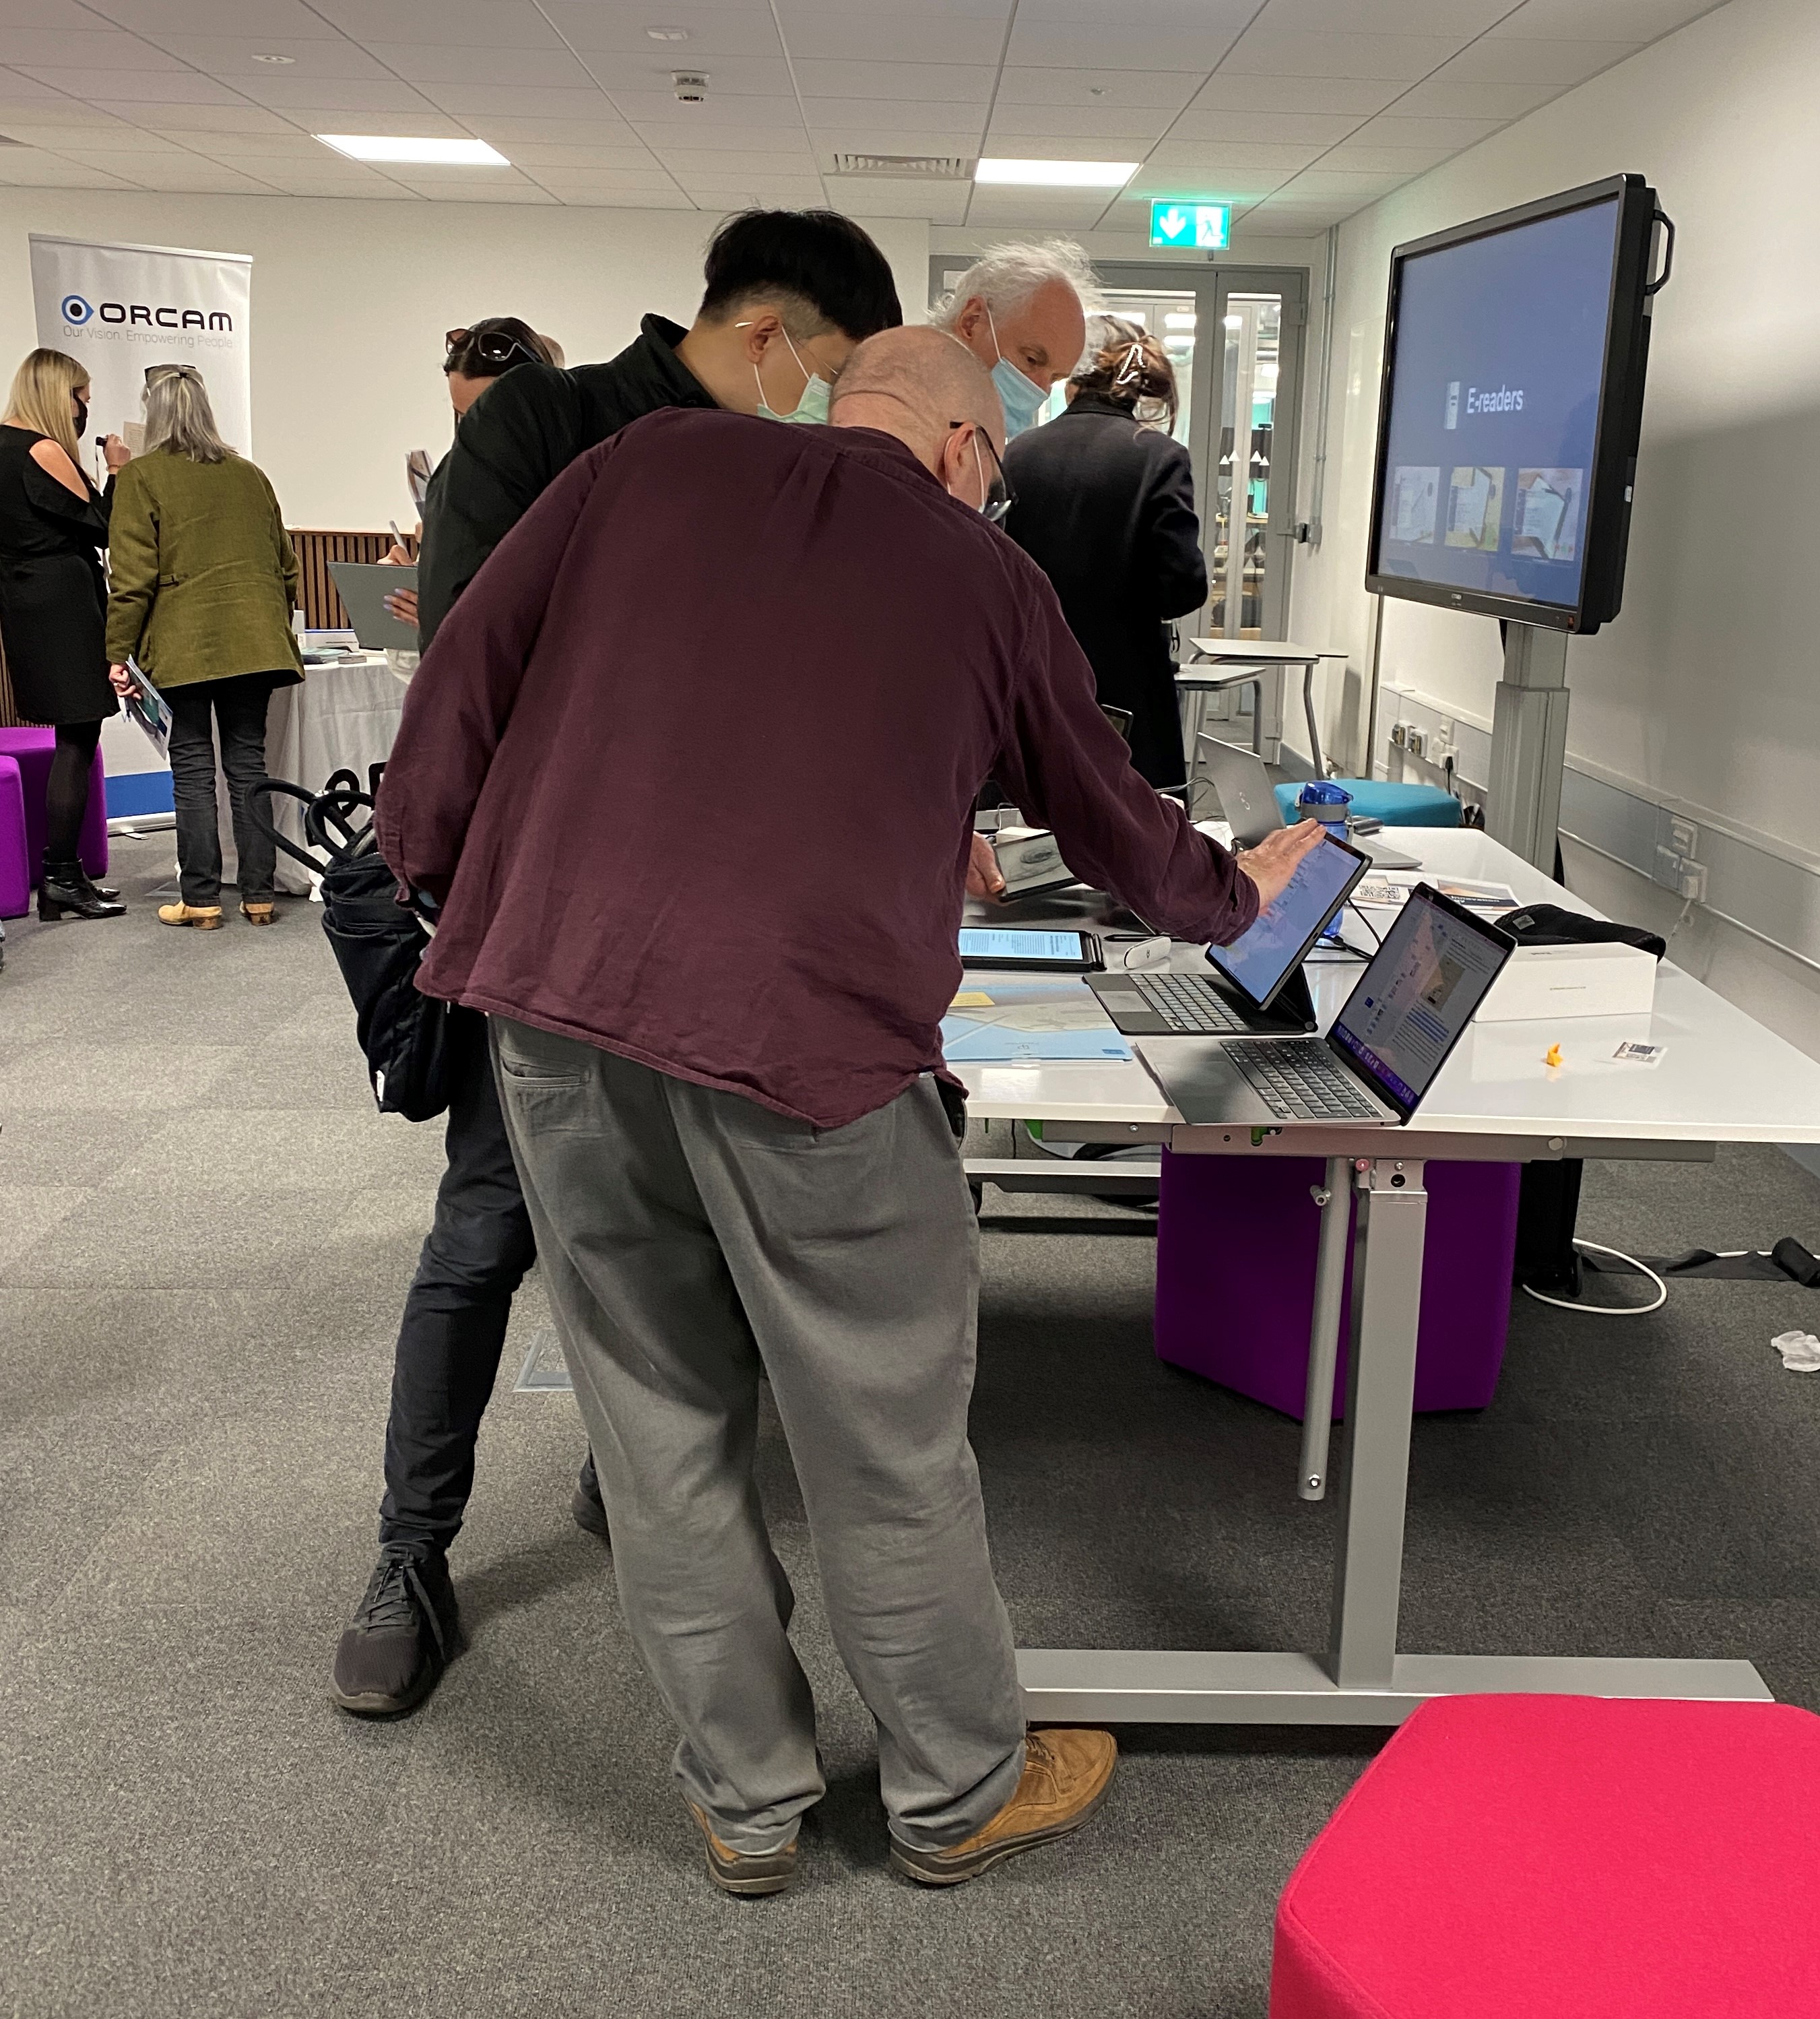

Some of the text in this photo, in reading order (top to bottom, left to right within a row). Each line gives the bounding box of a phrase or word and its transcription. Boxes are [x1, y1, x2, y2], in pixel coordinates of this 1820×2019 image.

[100, 302, 232, 331] ORCAM
[63, 325, 84, 337] Our
[126, 329, 194, 348] Empowering
[197, 335, 232, 349] People
[1467, 384, 1524, 414] E-readers
